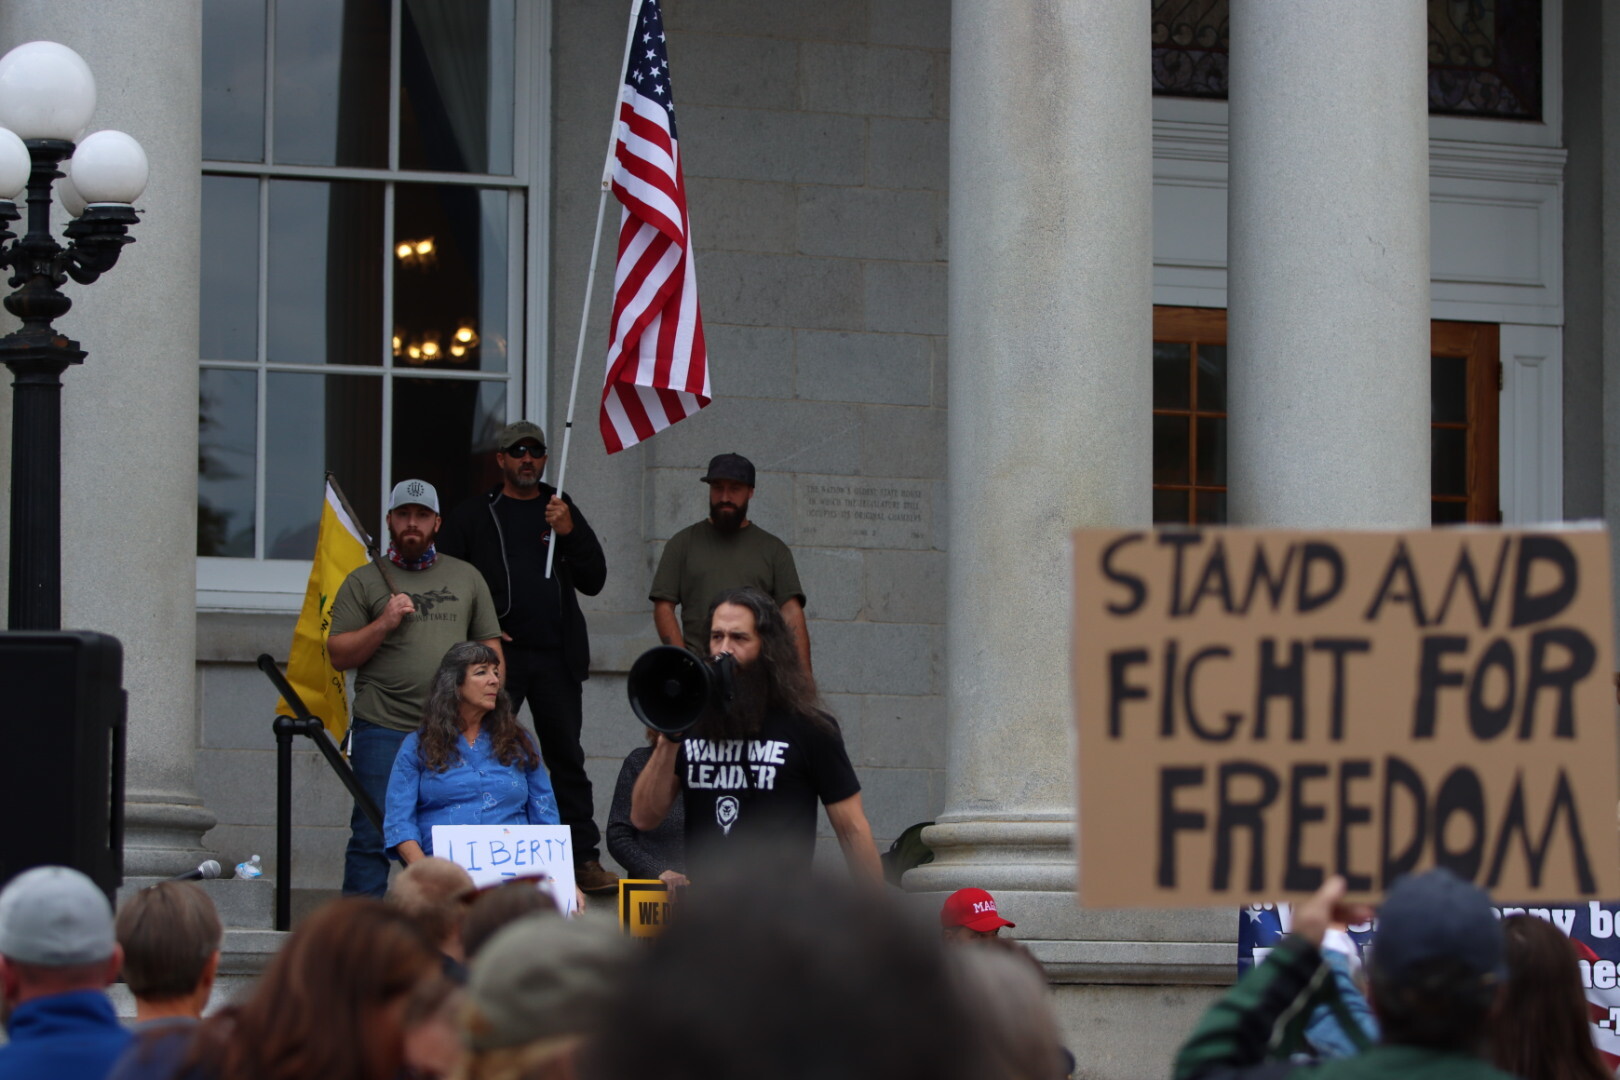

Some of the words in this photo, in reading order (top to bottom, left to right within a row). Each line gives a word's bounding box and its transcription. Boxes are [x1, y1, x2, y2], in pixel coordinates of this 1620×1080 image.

[880, 488, 898, 497] STATE
[1099, 532, 1347, 618] STAND
[1362, 534, 1580, 630] AND
[1106, 636, 1373, 742] FIGHT
[1410, 627, 1598, 742] FOR
[1155, 755, 1598, 895] FREEDOM
[638, 901, 659, 925] WE
